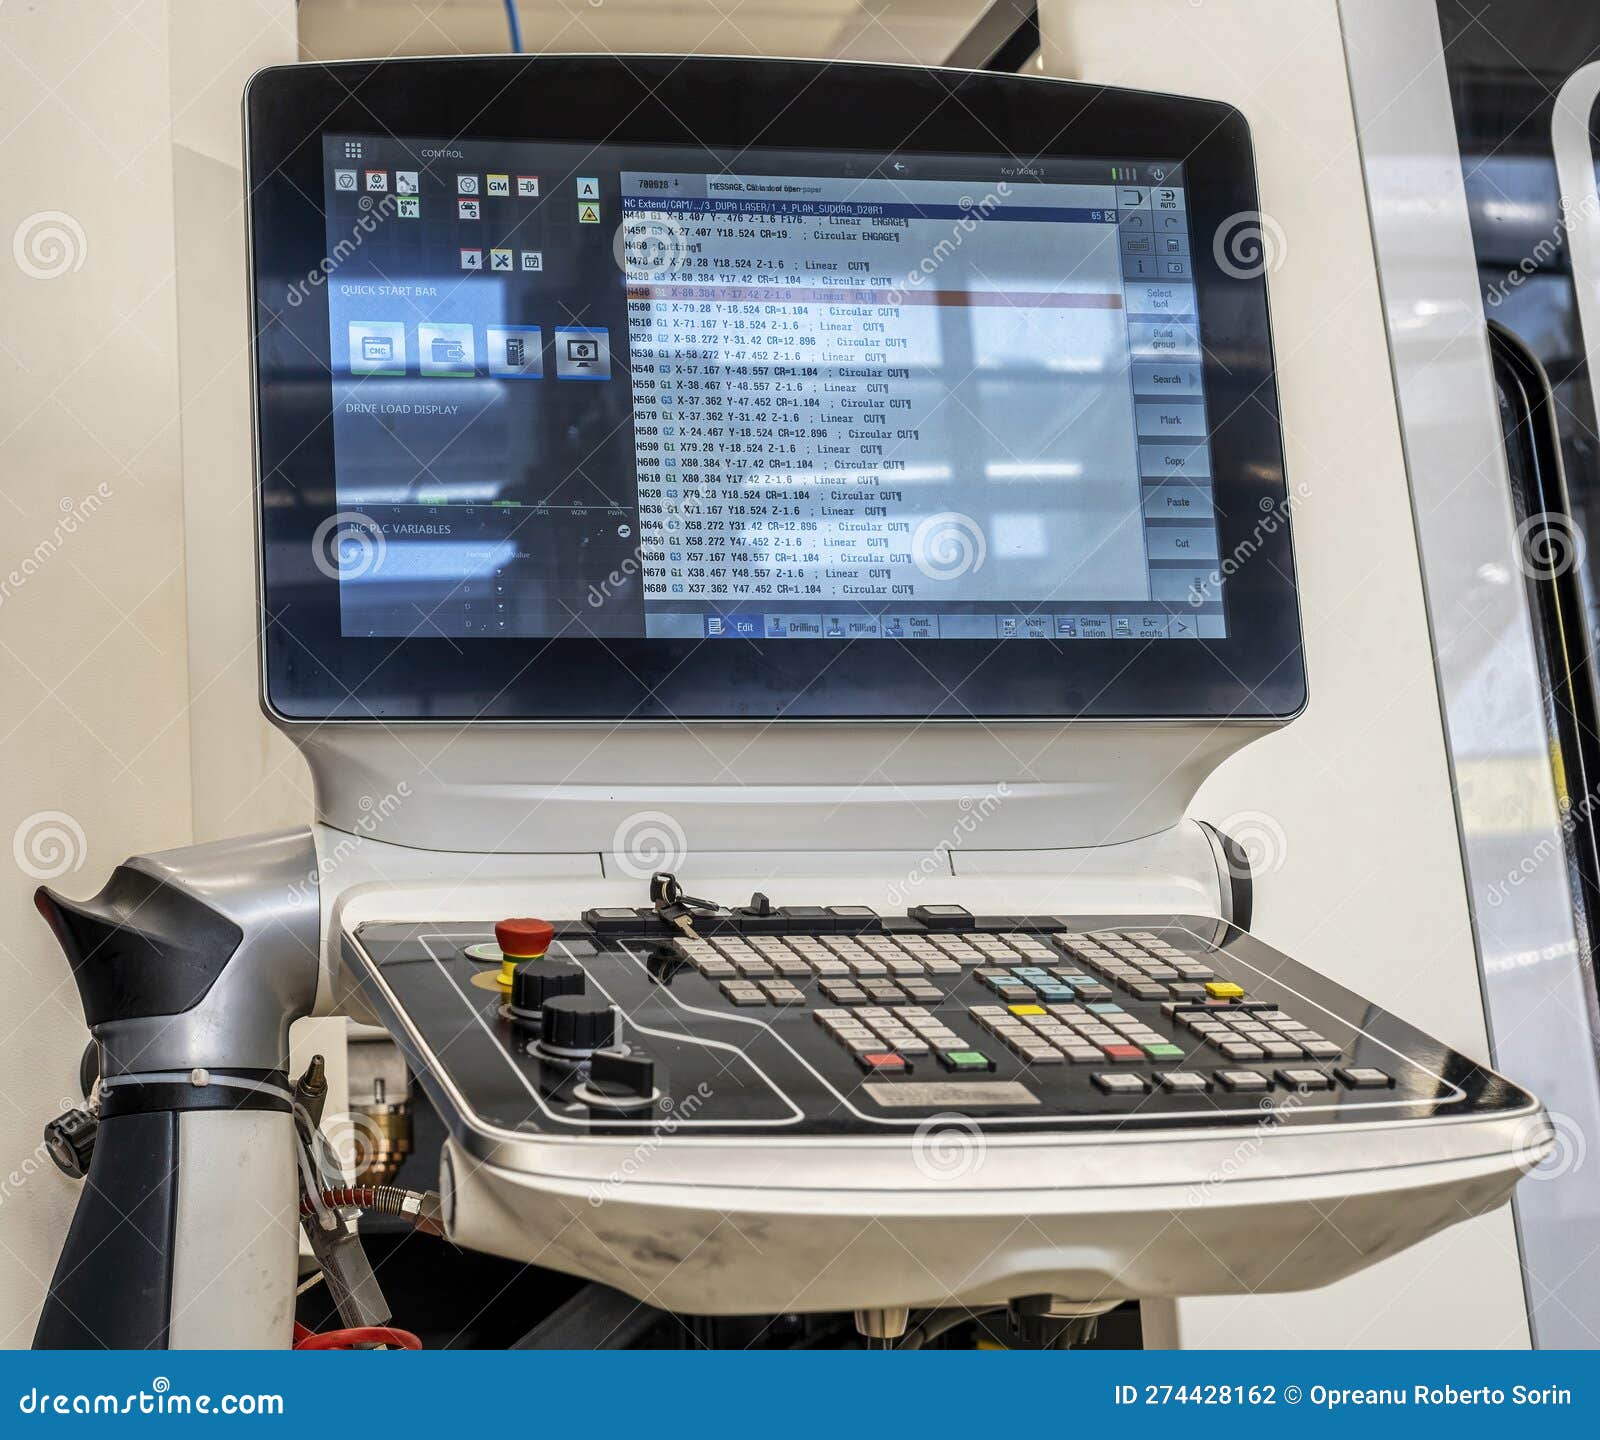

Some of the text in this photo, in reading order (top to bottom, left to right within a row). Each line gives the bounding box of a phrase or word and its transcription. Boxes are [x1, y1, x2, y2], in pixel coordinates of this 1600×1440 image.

[421, 149, 464, 160] CONTROL
[1001, 167, 1014, 177] Key
[489, 181, 508, 192] GM
[584, 184, 593, 195] A
[1160, 201, 1177, 209] AUTO
[467, 254, 476, 265] 4
[805, 260, 837, 270] Linear
[341, 285, 438, 298] QUICK START BAR
[1147, 288, 1173, 298] Select
[1153, 299, 1169, 308] tool
[1153, 328, 1173, 339] Build
[1152, 340, 1176, 350] group
[368, 346, 387, 356] CNC
[659, 365, 670, 374] G3
[839, 367, 882, 377] Circular
[1152, 373, 1182, 385] Search
[660, 380, 671, 389] G1
[823, 382, 856, 392] Linear
[661, 395, 672, 405] G3
[841, 398, 884, 408] Circular
[346, 403, 459, 416] DRIVE LOAD DISPLAY
[662, 411, 673, 420] G1
[820, 413, 853, 423] Linear
[1160, 415, 1183, 425] Mark
[663, 427, 674, 436] G2
[848, 429, 892, 439] Circular
[664, 442, 675, 452] G1
[817, 444, 850, 454] Linear
[665, 458, 676, 467] G3
[834, 459, 878, 469] Circular
[1164, 456, 1185, 468] Copy
[1166, 497, 1190, 507] Paste
[350, 523, 451, 535] NC PLC VARIABLES
[1175, 538, 1191, 548] Cut
[671, 567, 682, 577] G1
[825, 569, 859, 578] Linear
[672, 584, 683, 593] G3
[843, 584, 887, 594] Circular
[737, 622, 754, 632] Edit
[909, 617, 932, 628] Cont.
[790, 622, 819, 635] Drilling
[849, 623, 877, 635] Milling
